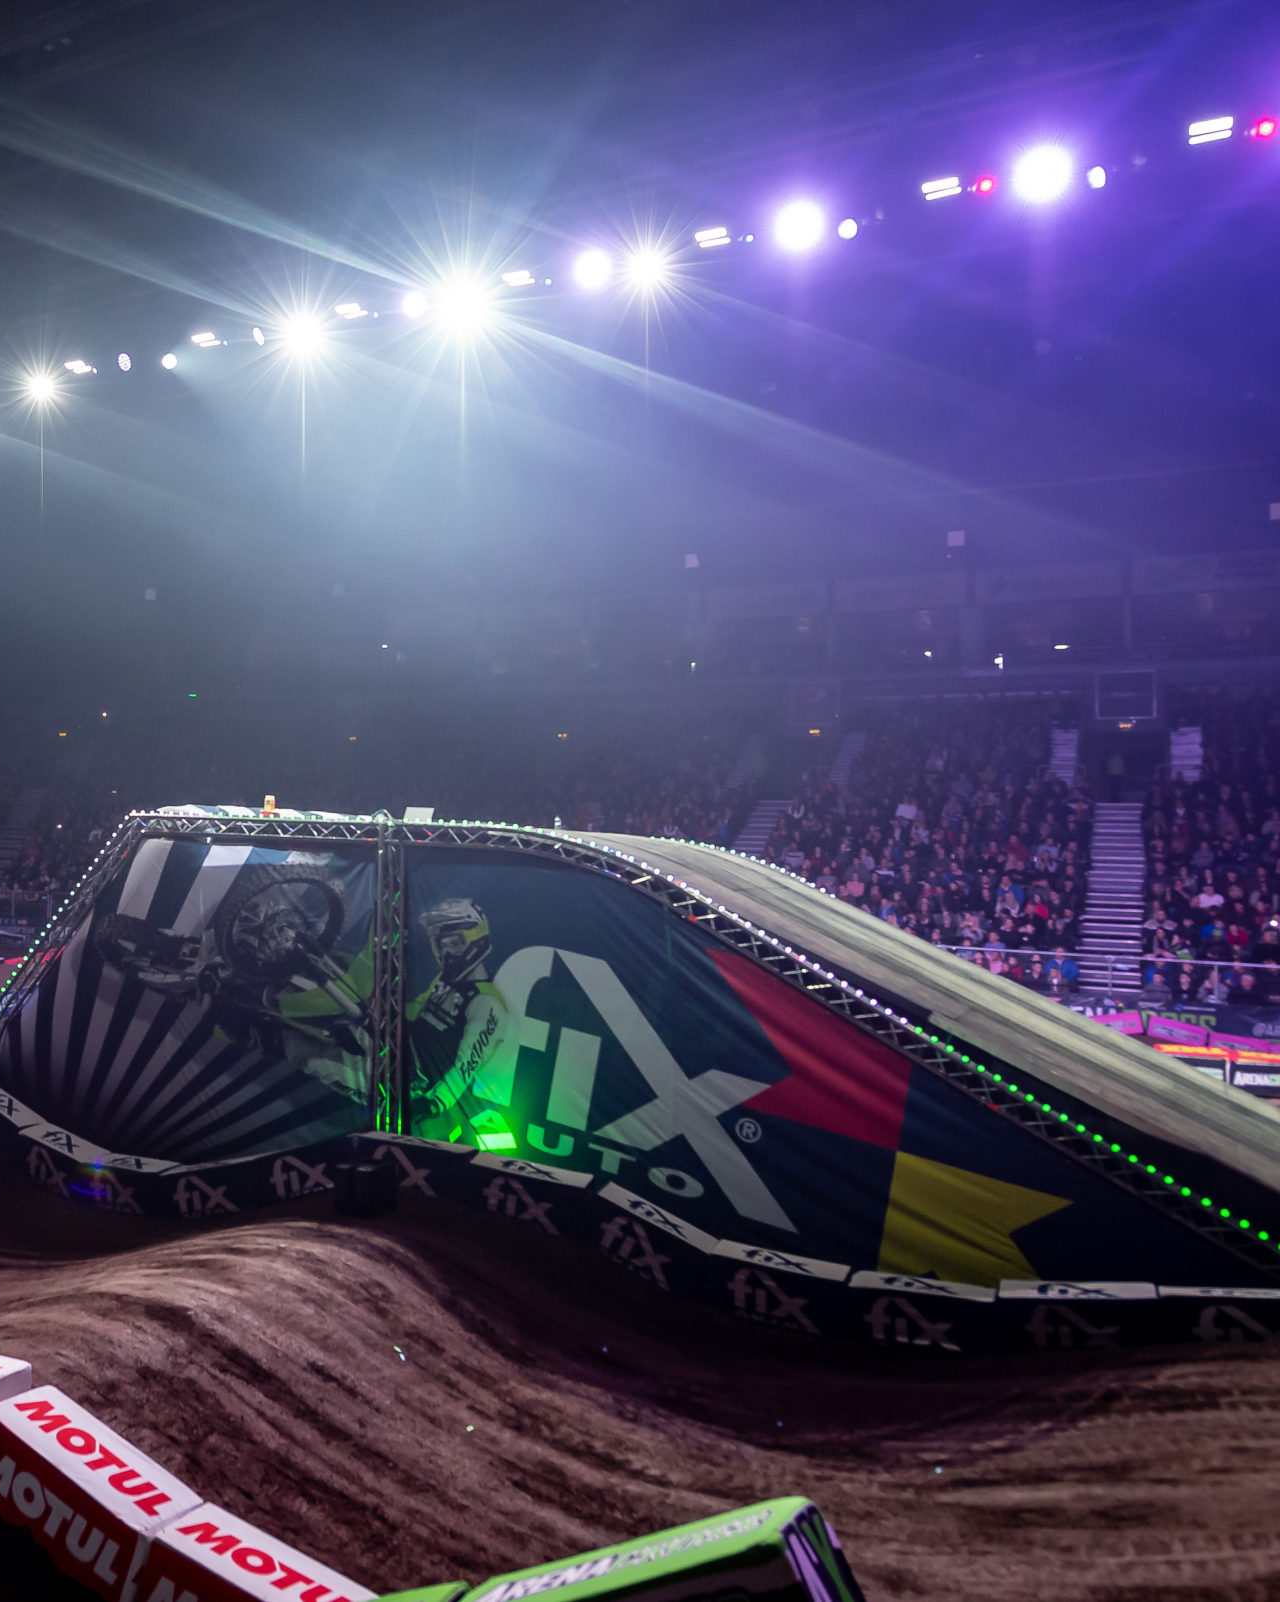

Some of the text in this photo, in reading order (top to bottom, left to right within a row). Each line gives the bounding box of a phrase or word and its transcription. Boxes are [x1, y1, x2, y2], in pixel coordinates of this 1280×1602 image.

[172, 1174, 241, 1217] fix
[270, 1154, 336, 1200] fix
[483, 1175, 561, 1236] fix
[600, 1216, 673, 1291] fix
[726, 1266, 823, 1337] fix
[864, 1294, 964, 1351] fix
[15, 1400, 174, 1517] MOTUL
[177, 1522, 354, 1602] MOTU
